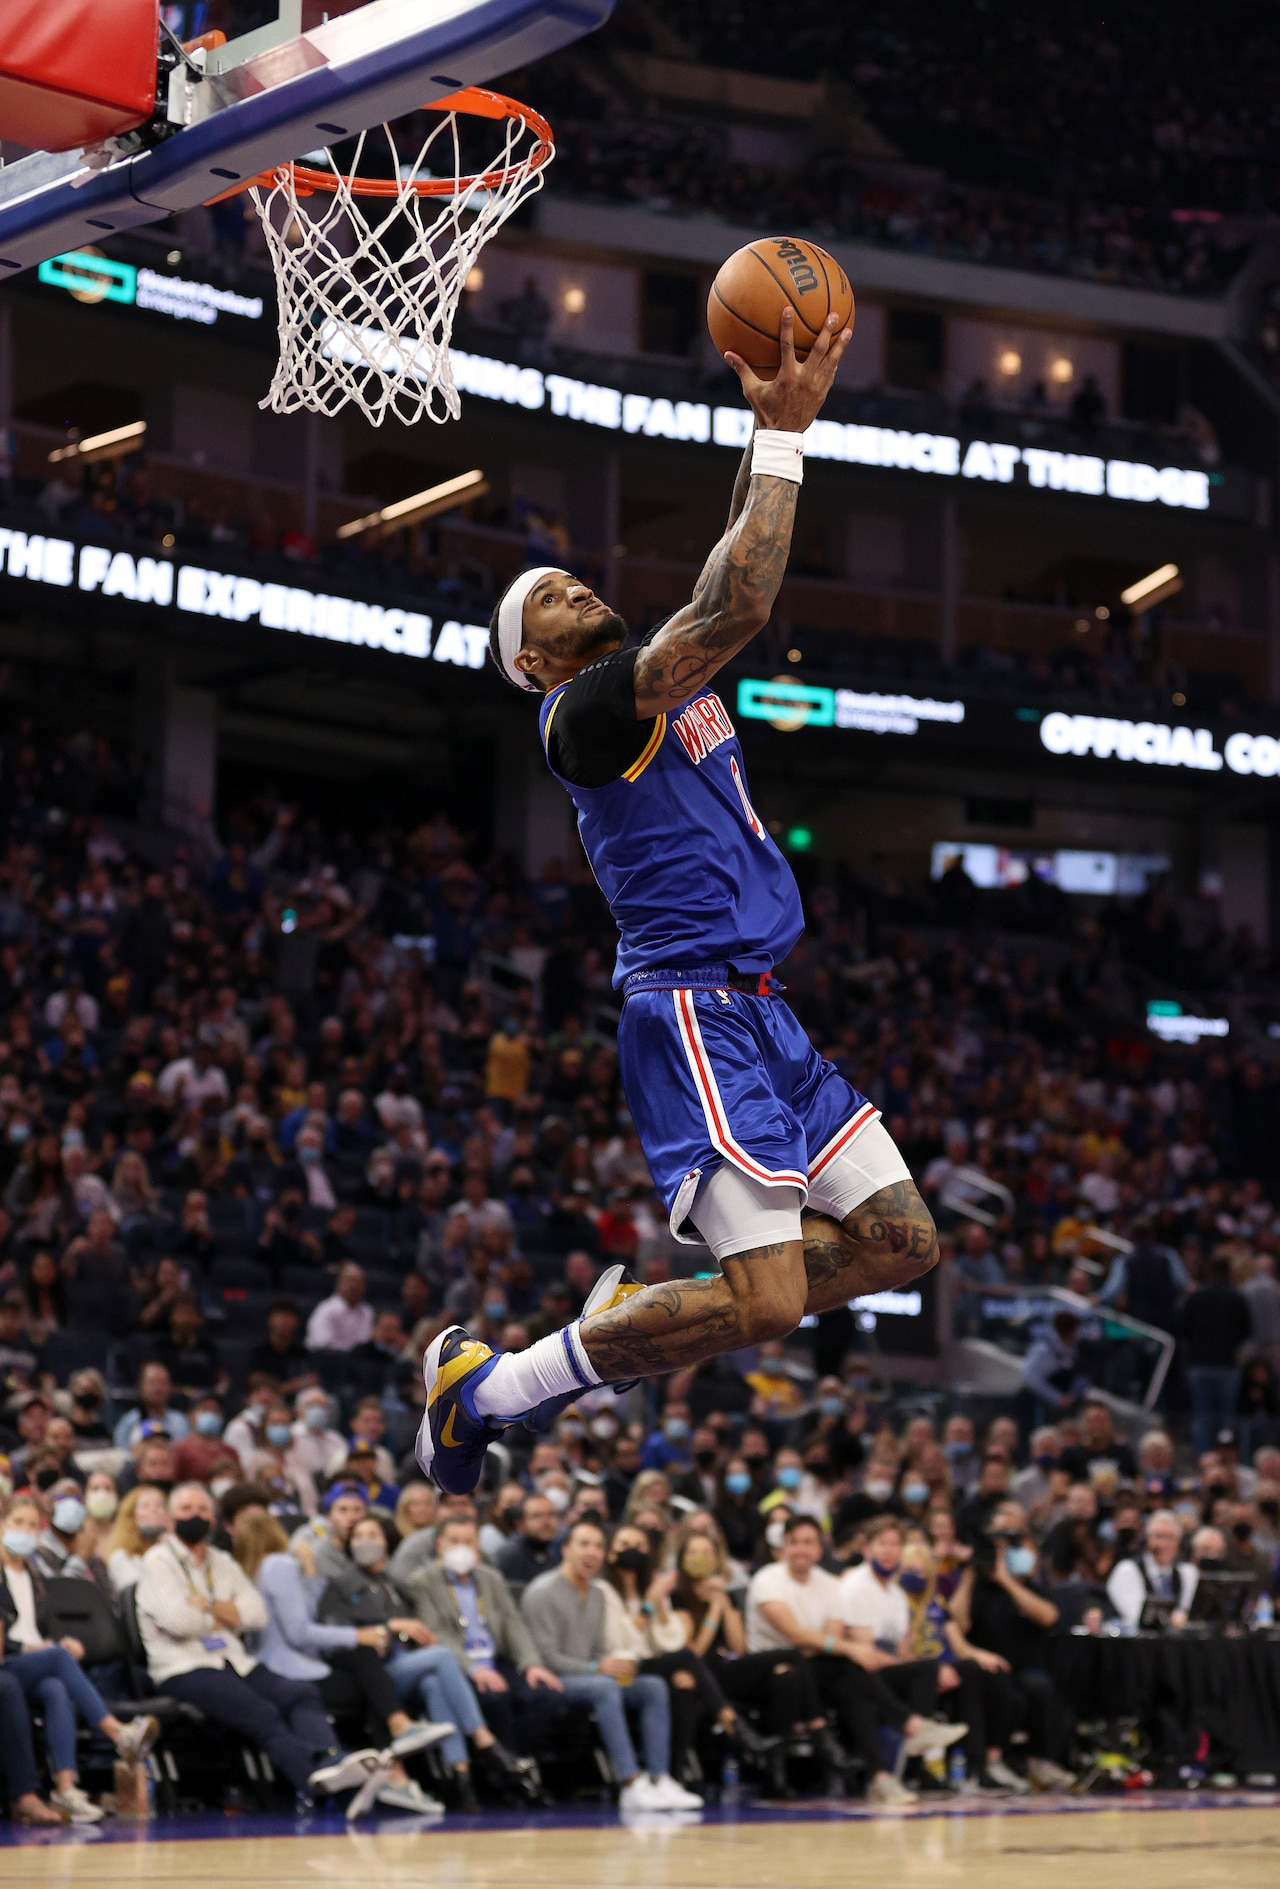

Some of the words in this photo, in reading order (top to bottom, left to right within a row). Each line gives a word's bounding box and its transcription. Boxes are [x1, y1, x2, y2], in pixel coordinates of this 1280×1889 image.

[545, 374, 622, 429] THE
[622, 393, 711, 443] FAN
[961, 440, 1021, 484] AT
[1021, 447, 1105, 496] THE
[1106, 459, 1210, 511] EDGE
[78, 544, 174, 607] FAN
[176, 564, 433, 659] EXPERIENCE
[432, 619, 491, 670] AT
[1039, 711, 1224, 772] OFFICIAL
[1224, 732, 1280, 778] CO
